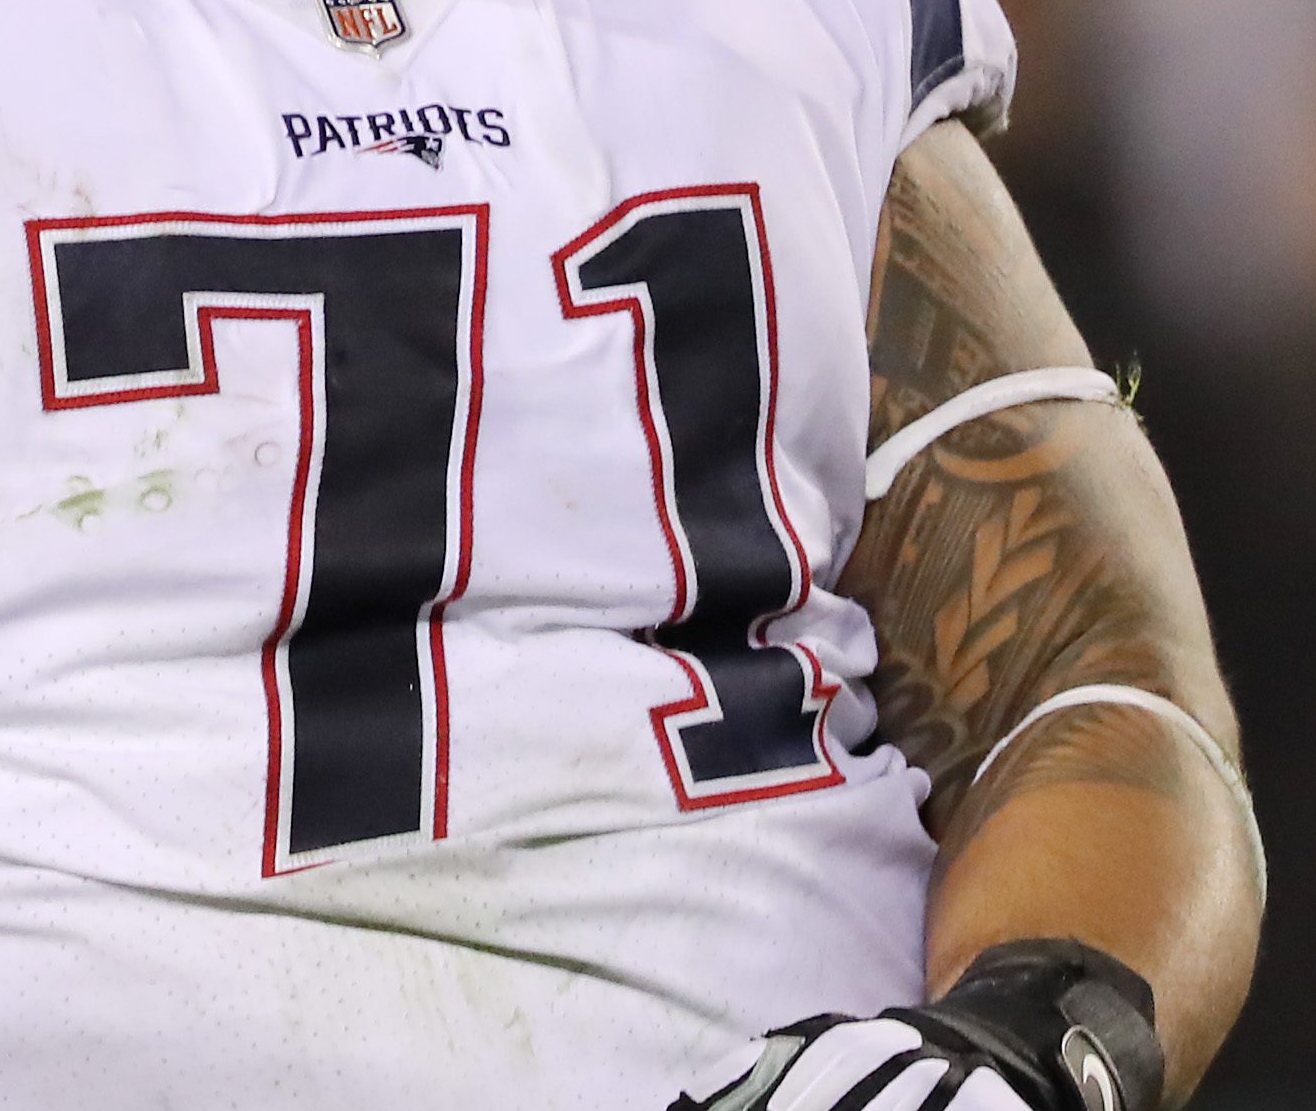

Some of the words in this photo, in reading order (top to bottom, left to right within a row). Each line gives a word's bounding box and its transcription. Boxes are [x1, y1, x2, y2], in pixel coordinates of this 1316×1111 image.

[334, 6, 399, 41] NFL
[282, 104, 511, 158] PATRIOTS
[25, 182, 846, 878] 71
